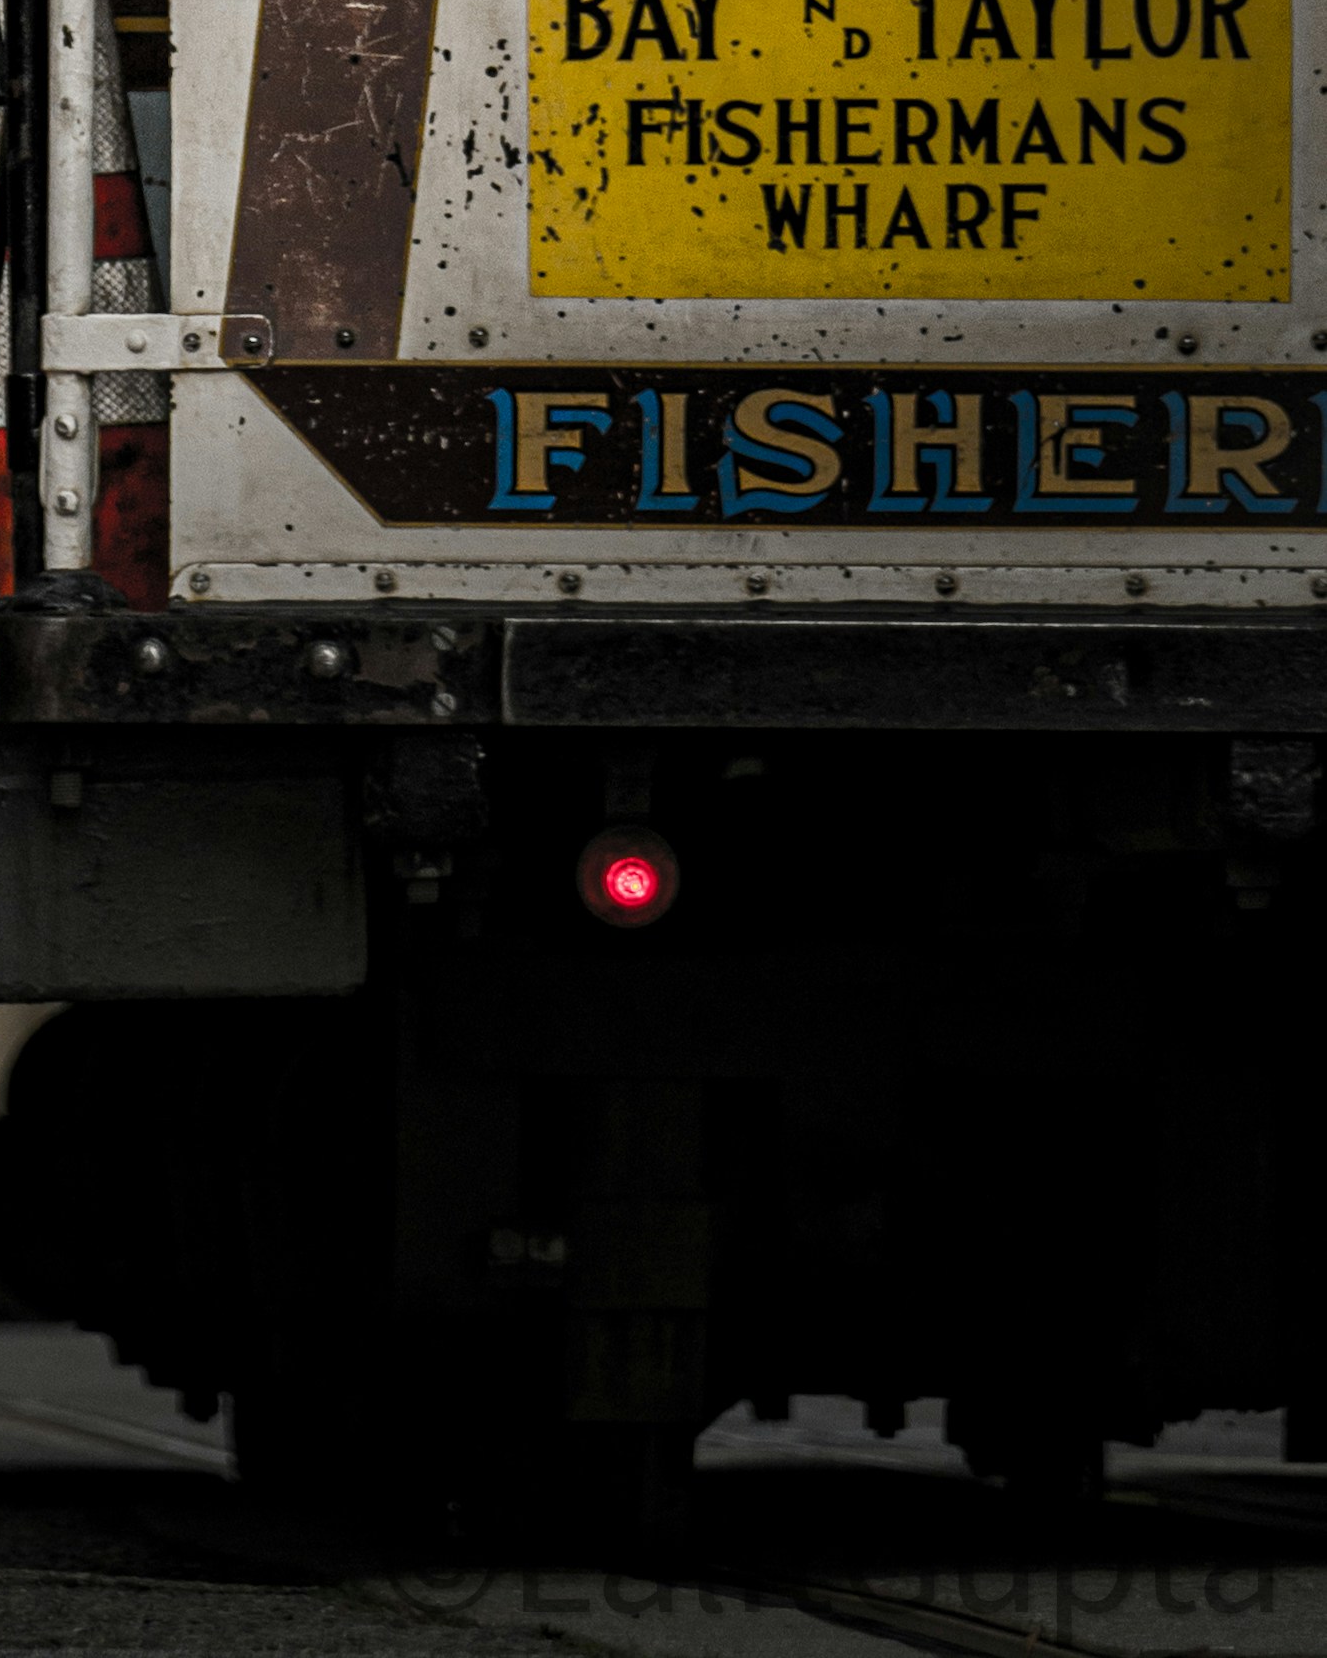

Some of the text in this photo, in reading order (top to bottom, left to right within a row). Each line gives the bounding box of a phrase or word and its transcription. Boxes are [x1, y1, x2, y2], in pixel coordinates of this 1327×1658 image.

[625, 96, 1188, 167] FISHERMANS
[759, 182, 1048, 250] WHARF
[487, 385, 1327, 520] FISHER
